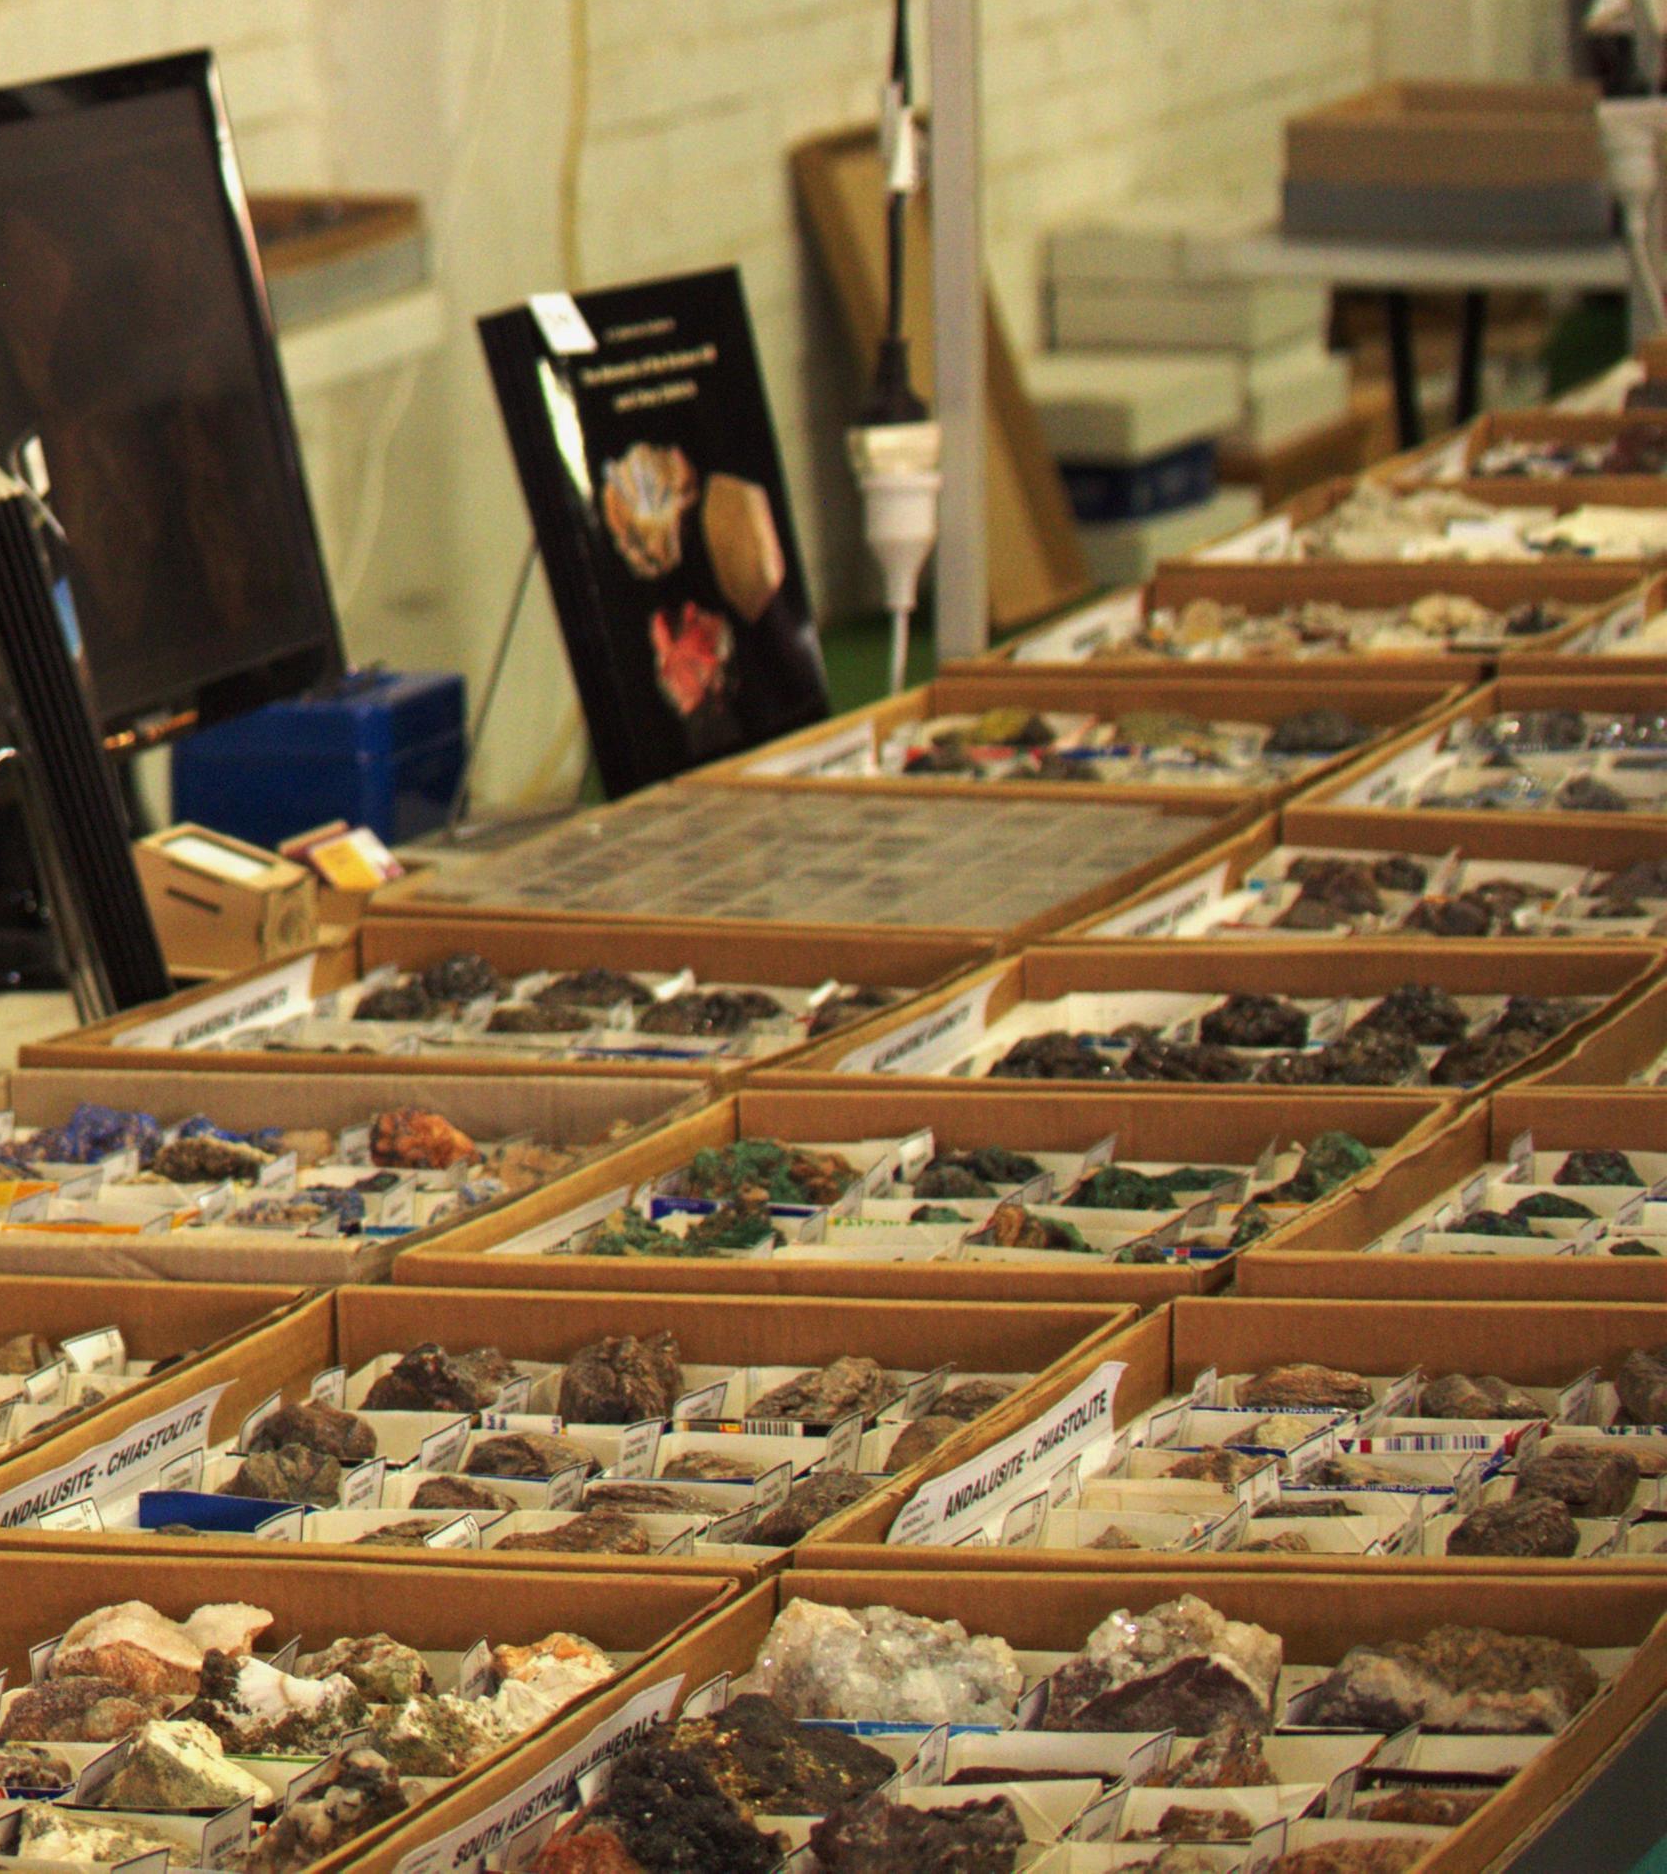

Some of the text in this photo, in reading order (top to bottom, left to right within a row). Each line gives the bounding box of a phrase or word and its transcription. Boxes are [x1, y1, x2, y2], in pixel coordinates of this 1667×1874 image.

[0, 1463, 97, 1528] ANDALUSITE
[106, 1405, 208, 1477] CHIASTOLITE
[944, 1450, 1027, 1522] ANDALUSITE
[1033, 1388, 1107, 1462] CHIASTOLITE
[453, 1821, 507, 1869] SOUTH
